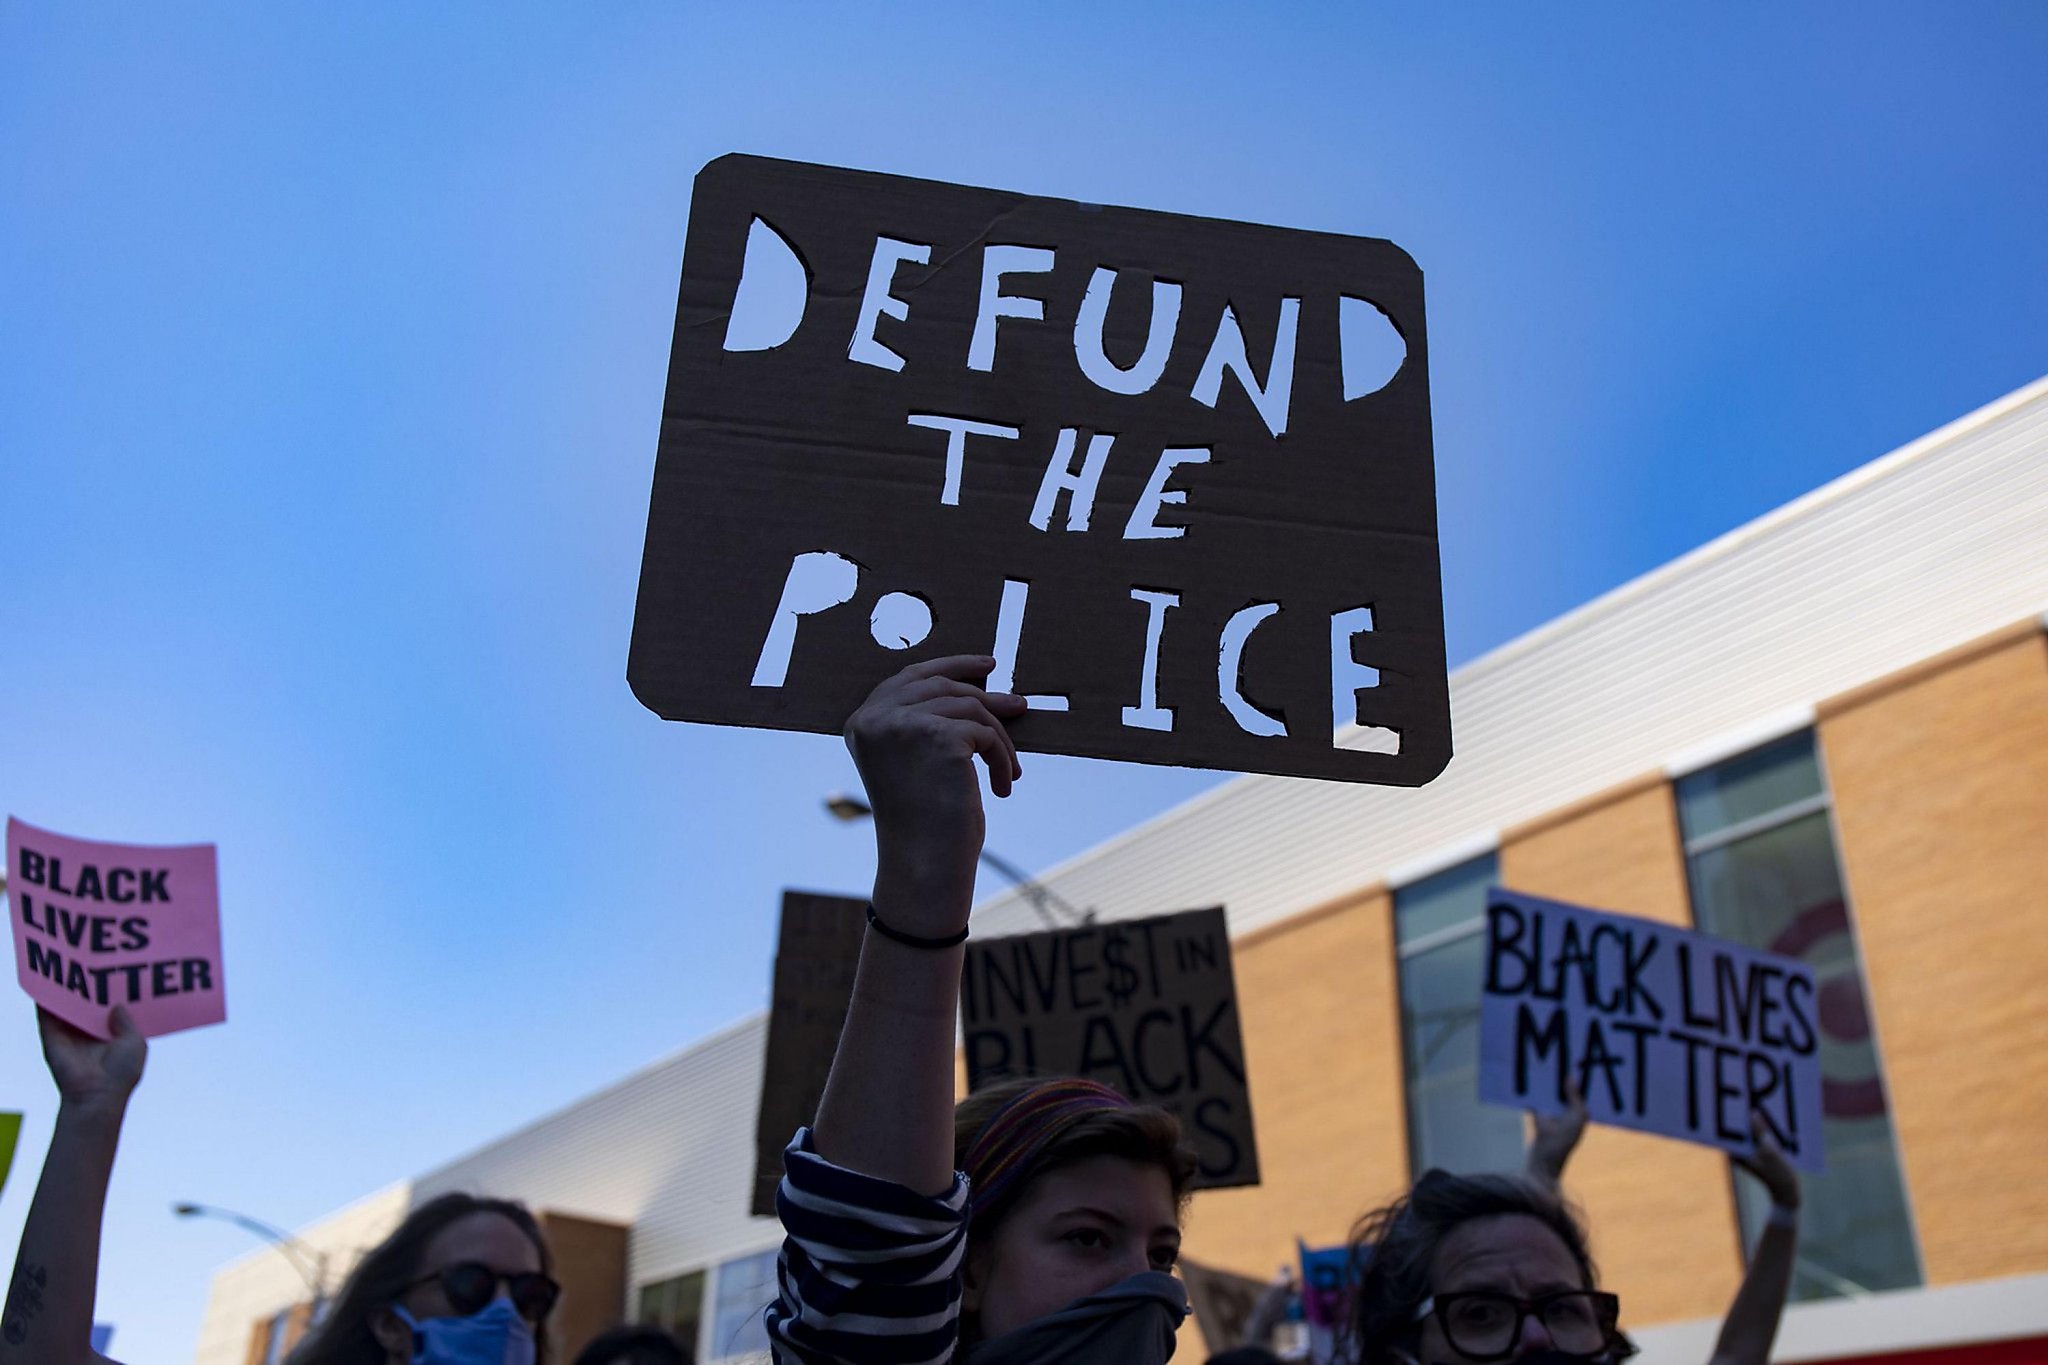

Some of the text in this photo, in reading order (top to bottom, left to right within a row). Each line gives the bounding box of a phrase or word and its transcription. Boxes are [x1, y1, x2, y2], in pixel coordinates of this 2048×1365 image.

[722, 212, 1408, 439] DEFUND
[906, 412, 1214, 540] THE
[750, 549, 1402, 755] POLICE
[20, 847, 171, 903] BLACK
[21, 892, 150, 953] LIVES
[26, 936, 212, 1006] MATTER
[1175, 934, 1218, 973] IN
[1484, 902, 1817, 1056] BLACK LIVES
[1514, 1002, 1799, 1156] MATTER!
